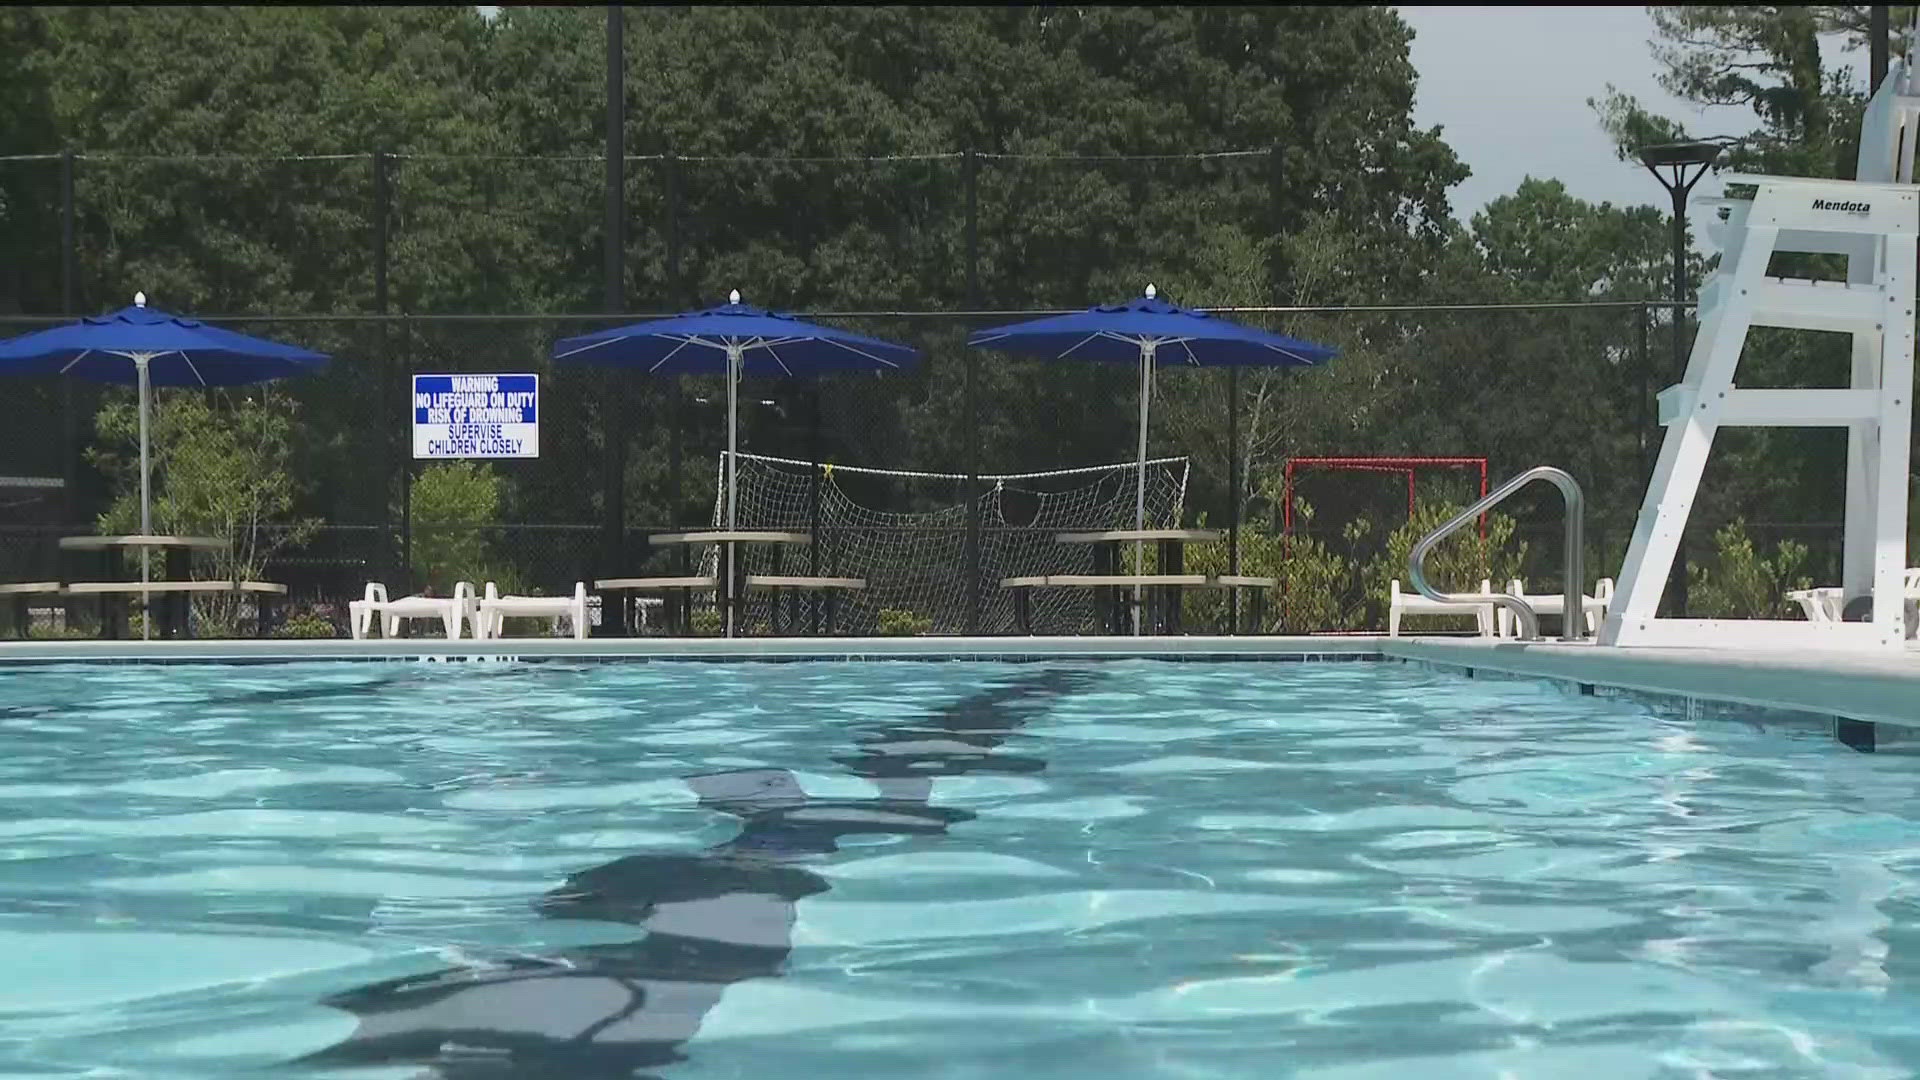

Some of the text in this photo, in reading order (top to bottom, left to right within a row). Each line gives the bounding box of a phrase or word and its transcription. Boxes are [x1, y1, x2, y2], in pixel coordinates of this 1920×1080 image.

[1812, 199, 1870, 212] Mendota
[451, 376, 499, 392] WARNING
[416, 392, 534, 408] NO LIFEGUARD ON DUTY
[428, 408, 523, 423] RISK OF DROWNING
[448, 424, 502, 439] SUPERVISE
[428, 439, 523, 454] CHILDREN CLOSELY
